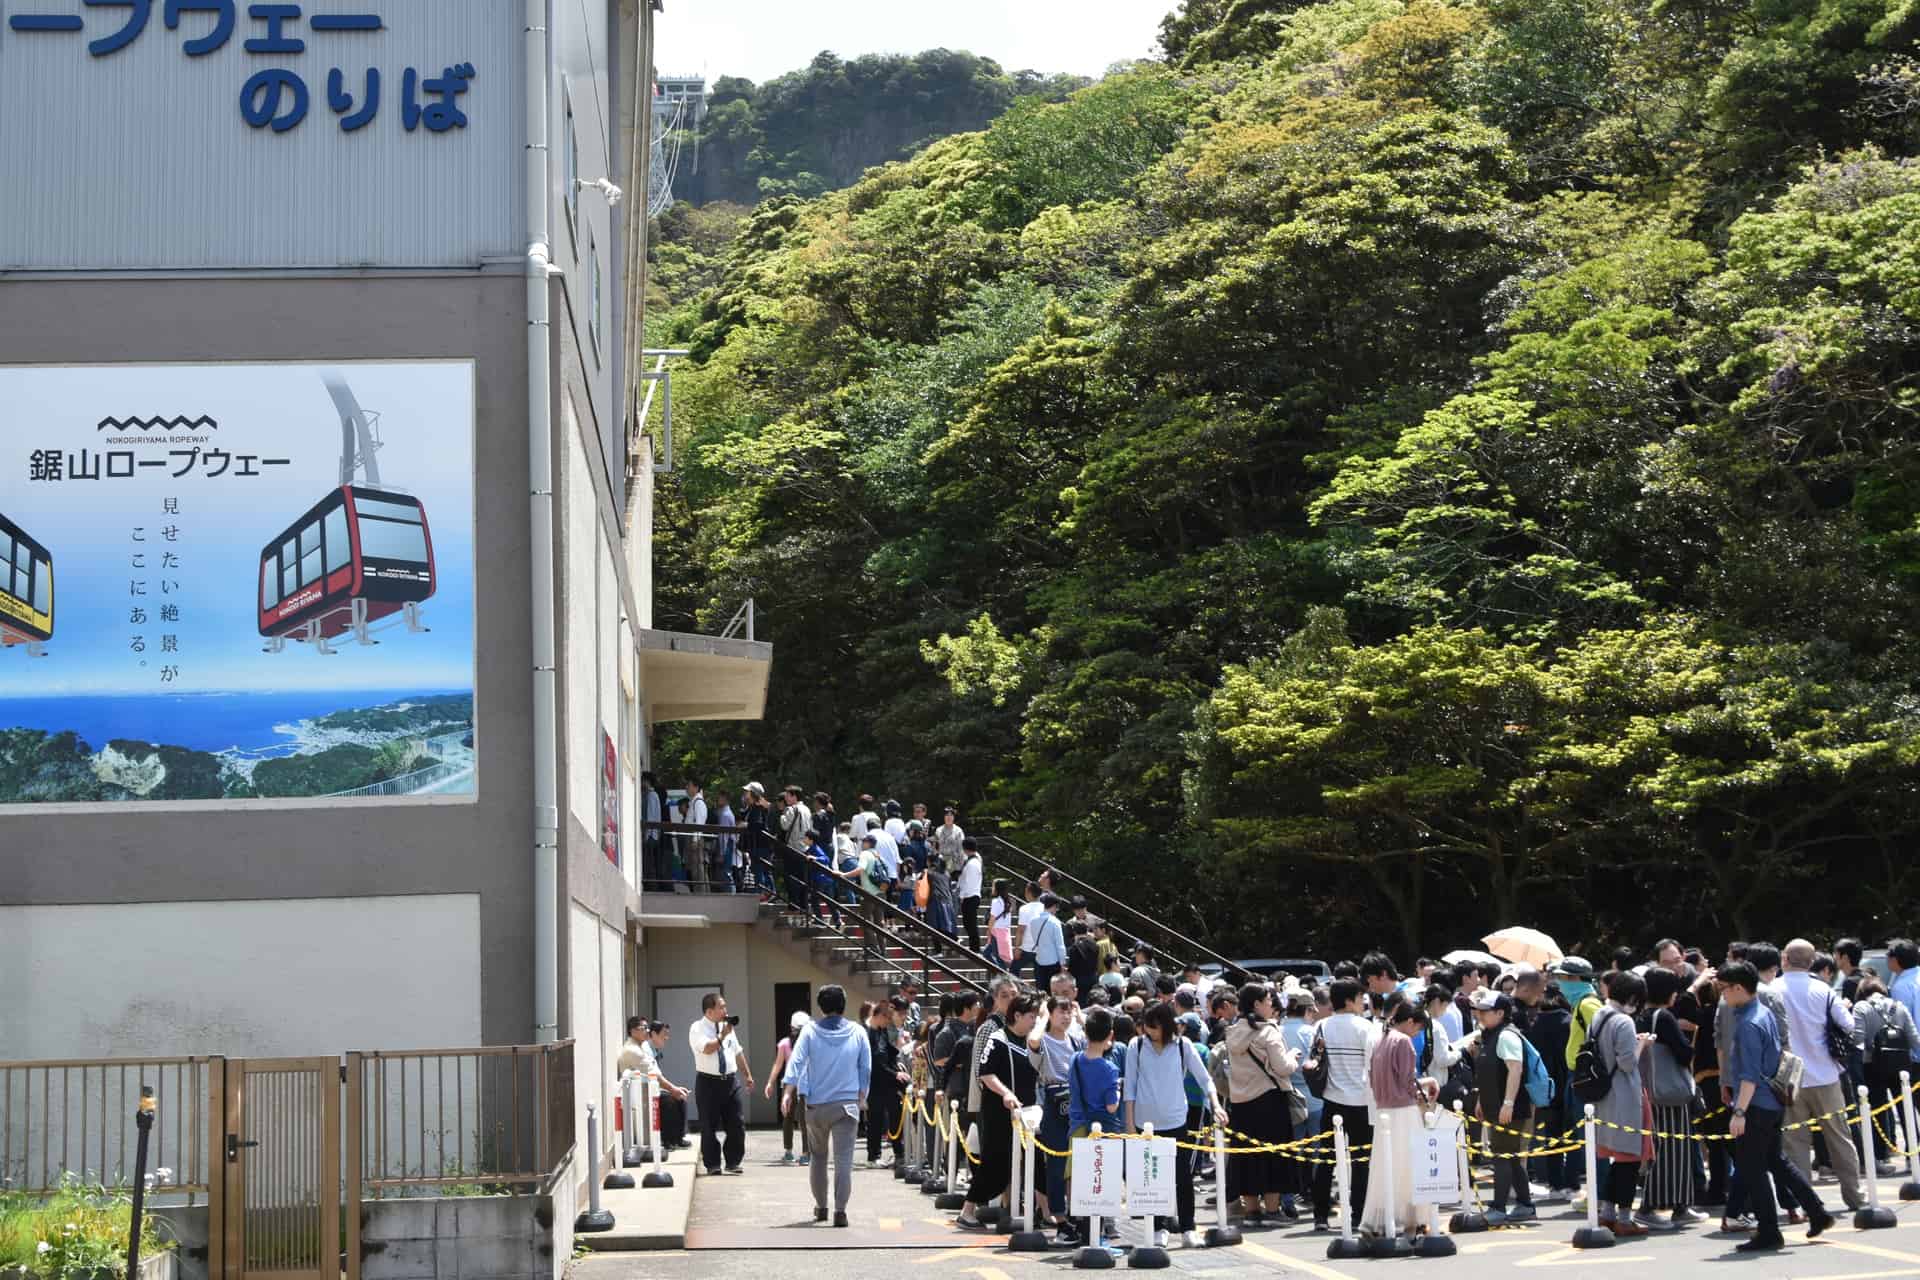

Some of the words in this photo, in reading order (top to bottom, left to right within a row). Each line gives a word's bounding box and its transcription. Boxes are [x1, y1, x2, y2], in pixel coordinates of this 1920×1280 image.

[240, 62, 475, 131] のりば
[30, 447, 290, 481] 鋸山ロープウェー
[106, 436, 167, 444] NOKOGIRIYAMA
[170, 435, 209, 443] ROPEWAY
[130, 527, 147, 667] ここにある。
[160, 497, 180, 682] 見せたい絶景が
